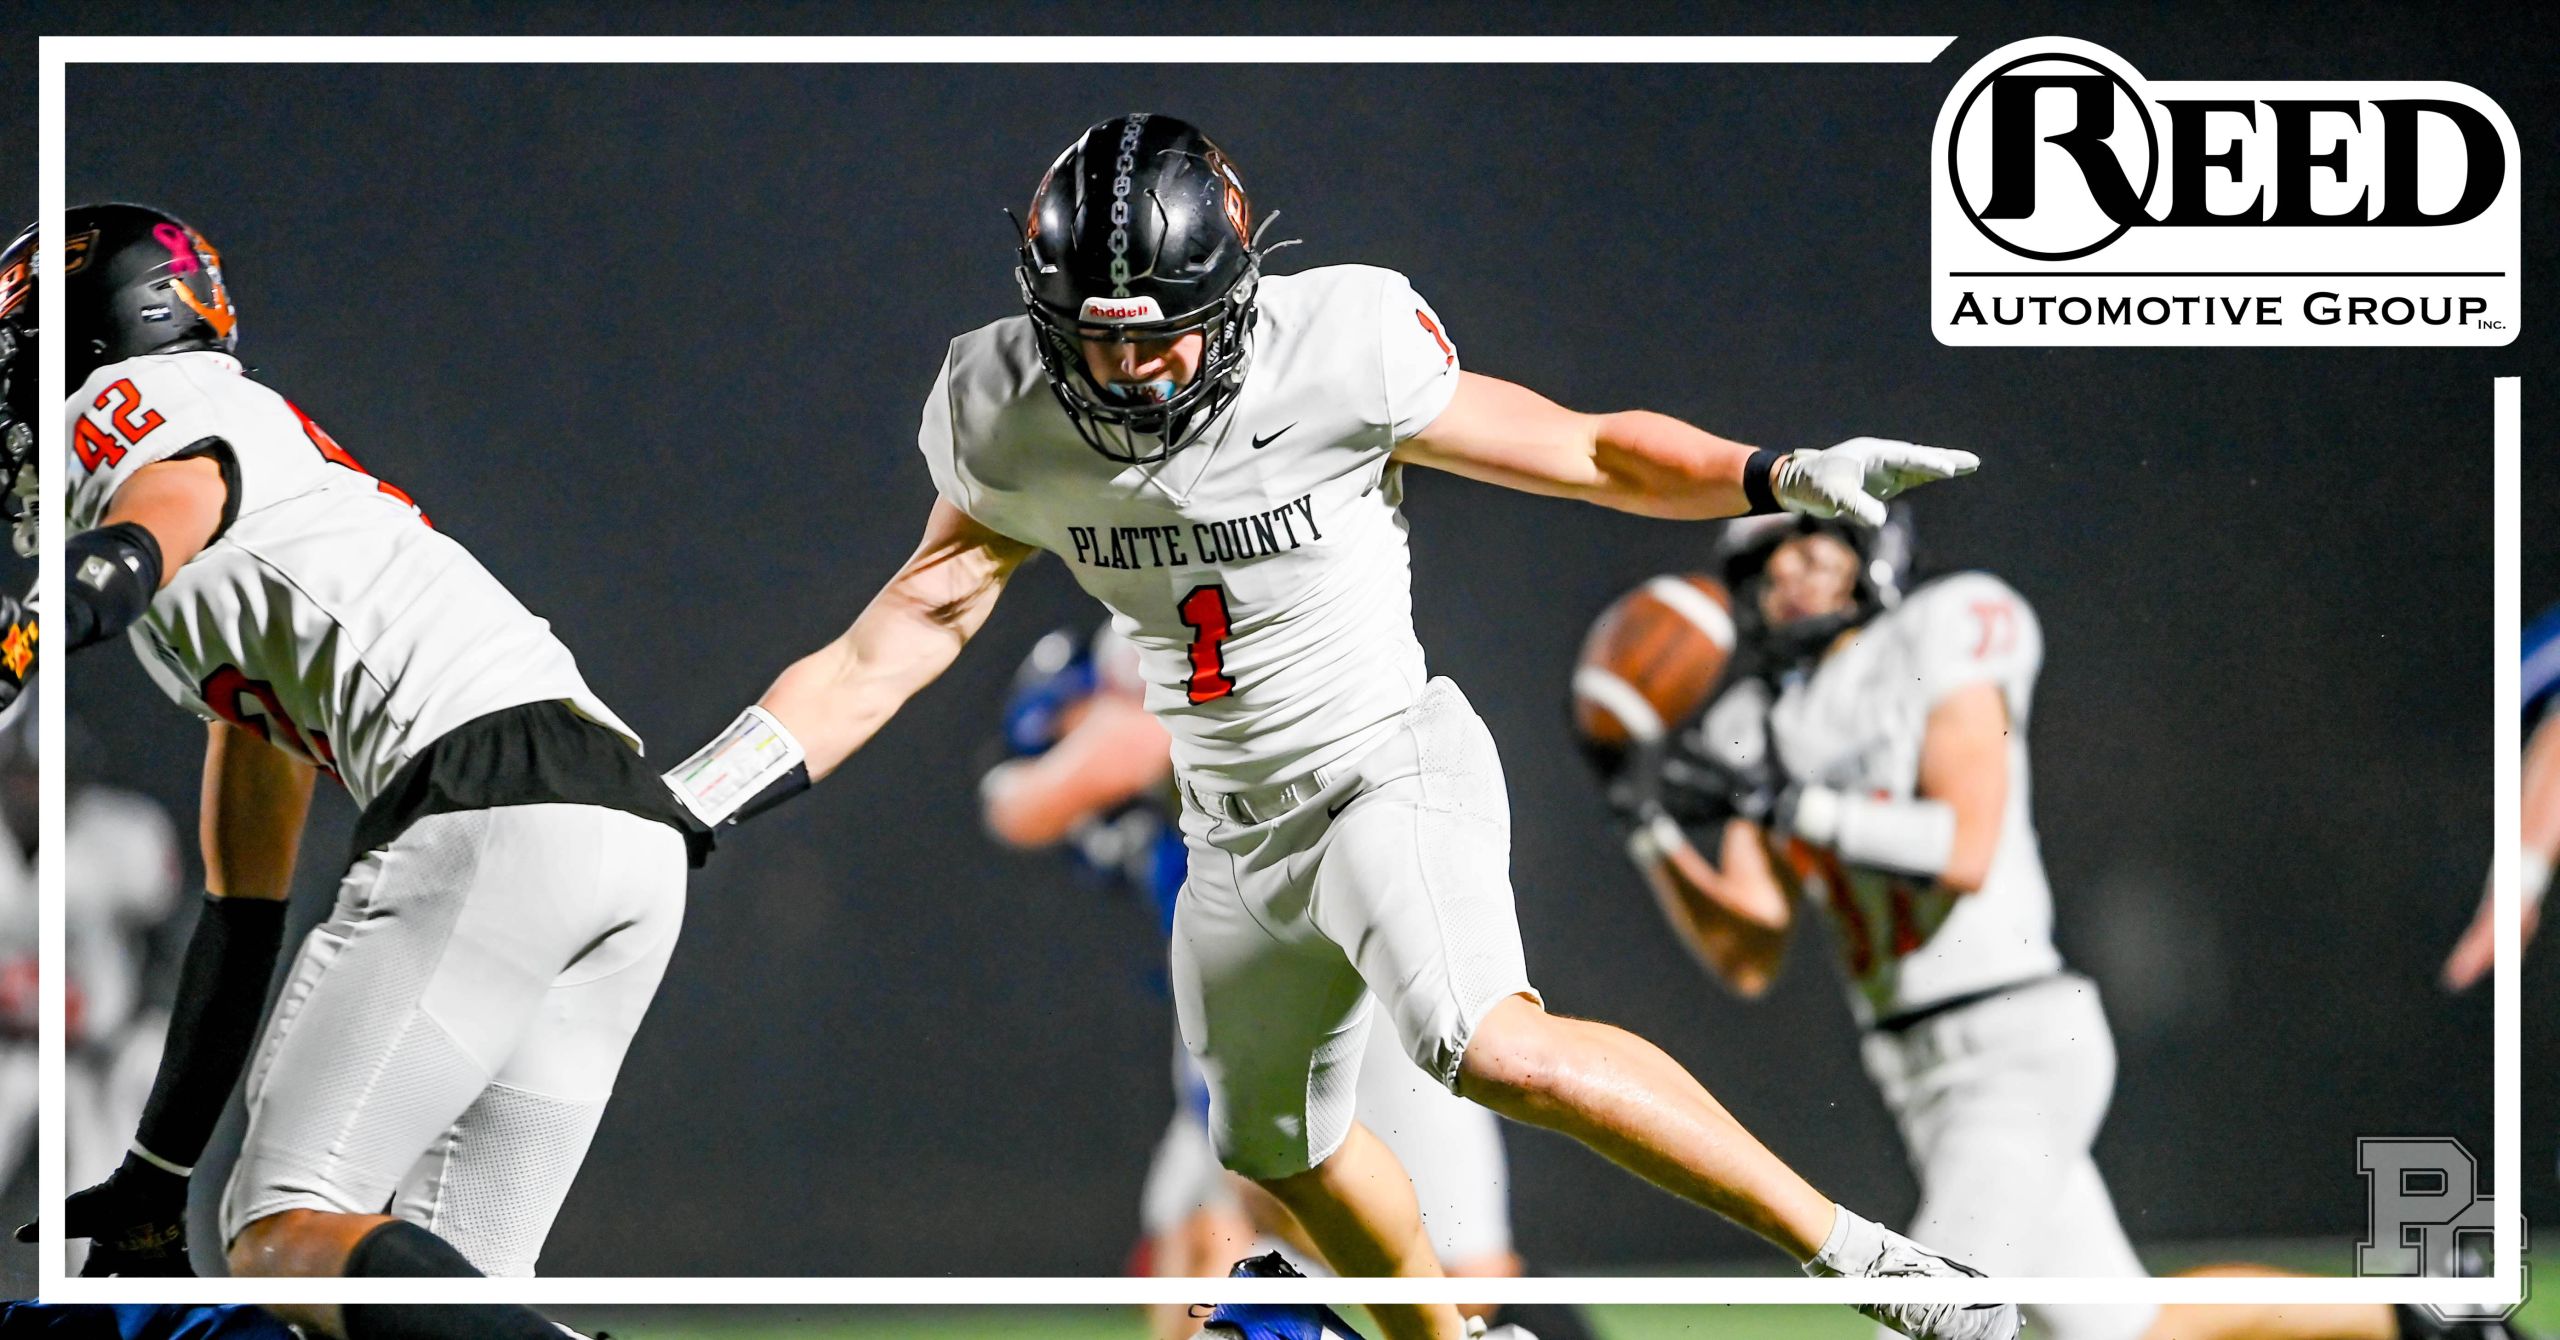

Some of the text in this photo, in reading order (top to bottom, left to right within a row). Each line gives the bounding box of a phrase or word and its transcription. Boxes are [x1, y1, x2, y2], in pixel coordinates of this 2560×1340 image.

[1088, 304, 1148, 319] Riddell
[72, 377, 166, 474] 42
[1067, 494, 1323, 570] PLATTE COUNTY
[1176, 583, 1237, 706] 1
